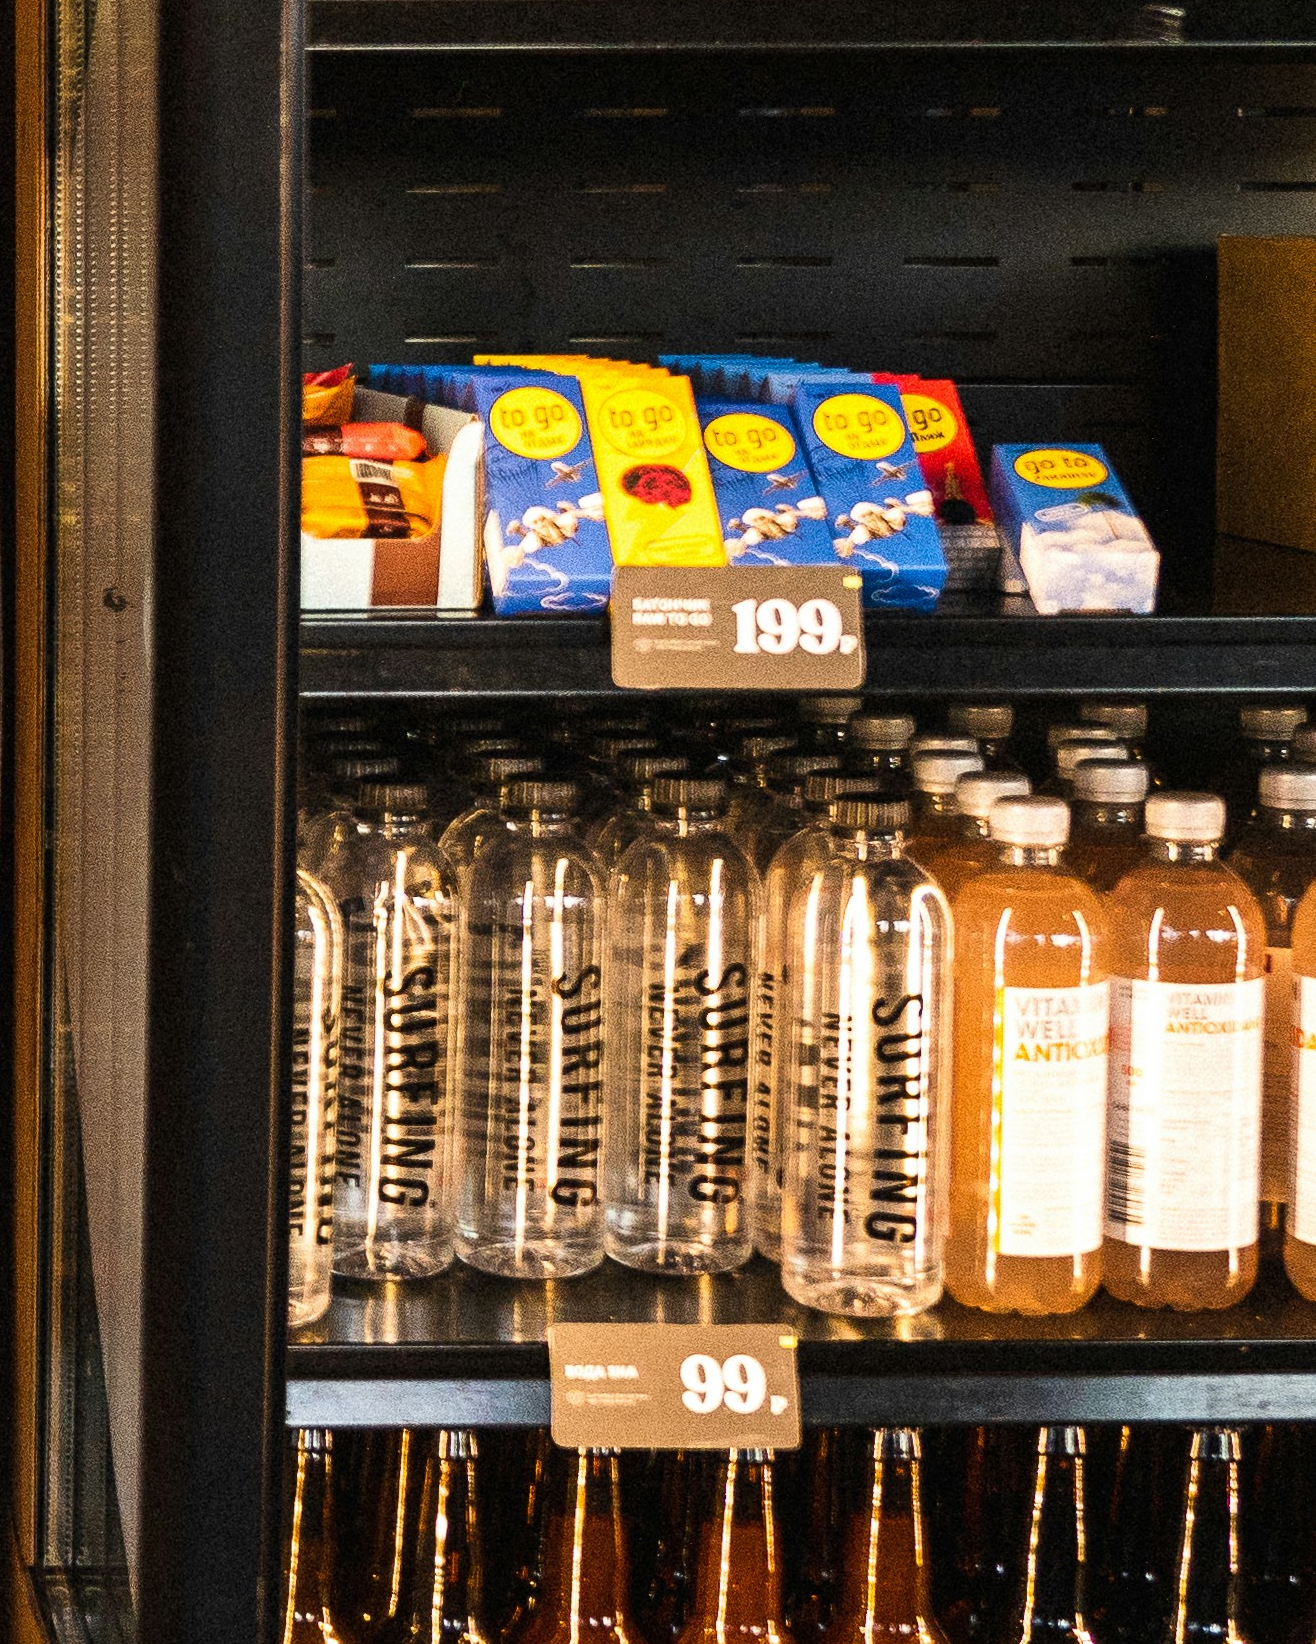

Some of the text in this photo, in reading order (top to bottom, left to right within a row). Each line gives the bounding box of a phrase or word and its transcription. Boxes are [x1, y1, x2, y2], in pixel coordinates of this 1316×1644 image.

[499, 404, 564, 430] to go
[609, 405, 673, 431] to go
[823, 410, 887, 433] to go
[913, 407, 943, 431] go
[712, 427, 777, 450] to go
[1024, 457, 1087, 474] go to
[667, 612, 686, 626] TO
[688, 612, 713, 626] GO
[378, 964, 439, 1206] SURFING
[550, 964, 602, 1207] SURFING
[688, 961, 748, 1205] SURFING
[863, 993, 924, 1244] SURFING
